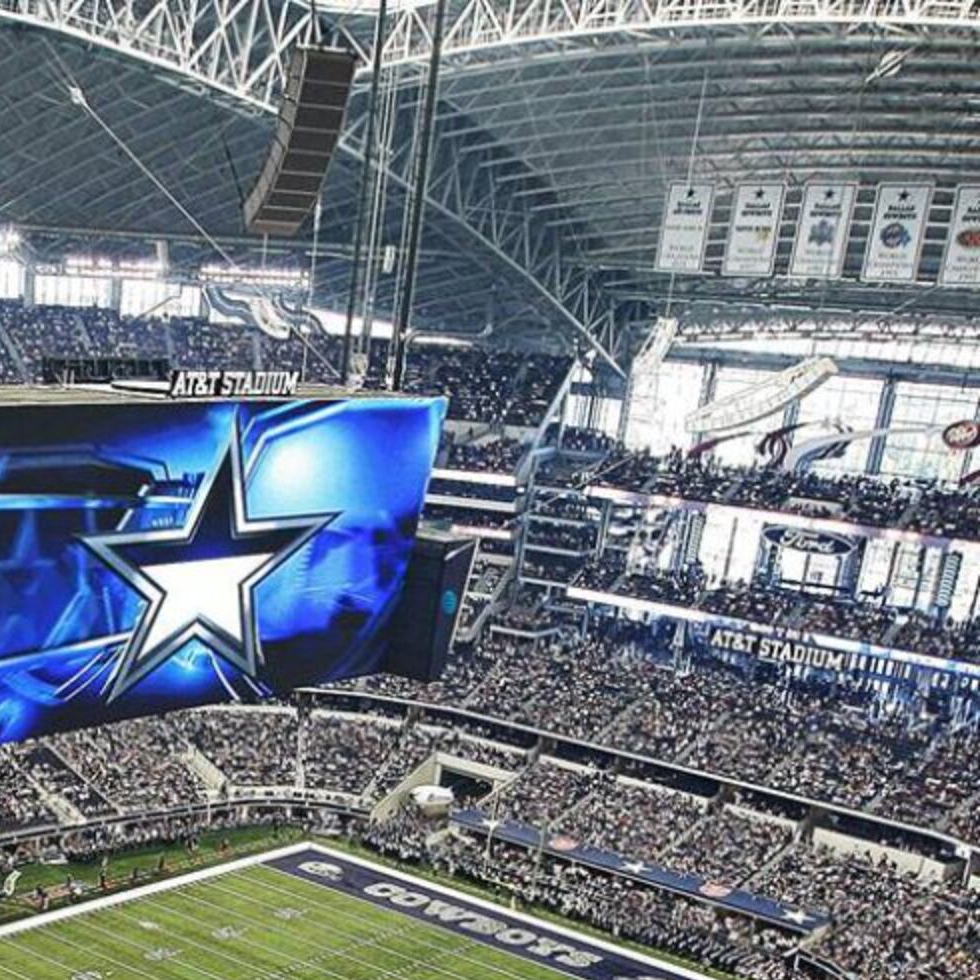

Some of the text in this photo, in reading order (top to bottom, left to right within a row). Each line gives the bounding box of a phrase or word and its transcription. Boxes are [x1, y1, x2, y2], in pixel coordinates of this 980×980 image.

[172, 371, 299, 396] AT&T STADIUM
[779, 527, 836, 553] Ford
[710, 629, 758, 653] AT&T
[759, 638, 844, 672] STADIUM
[363, 882, 604, 968] COWBOYS
